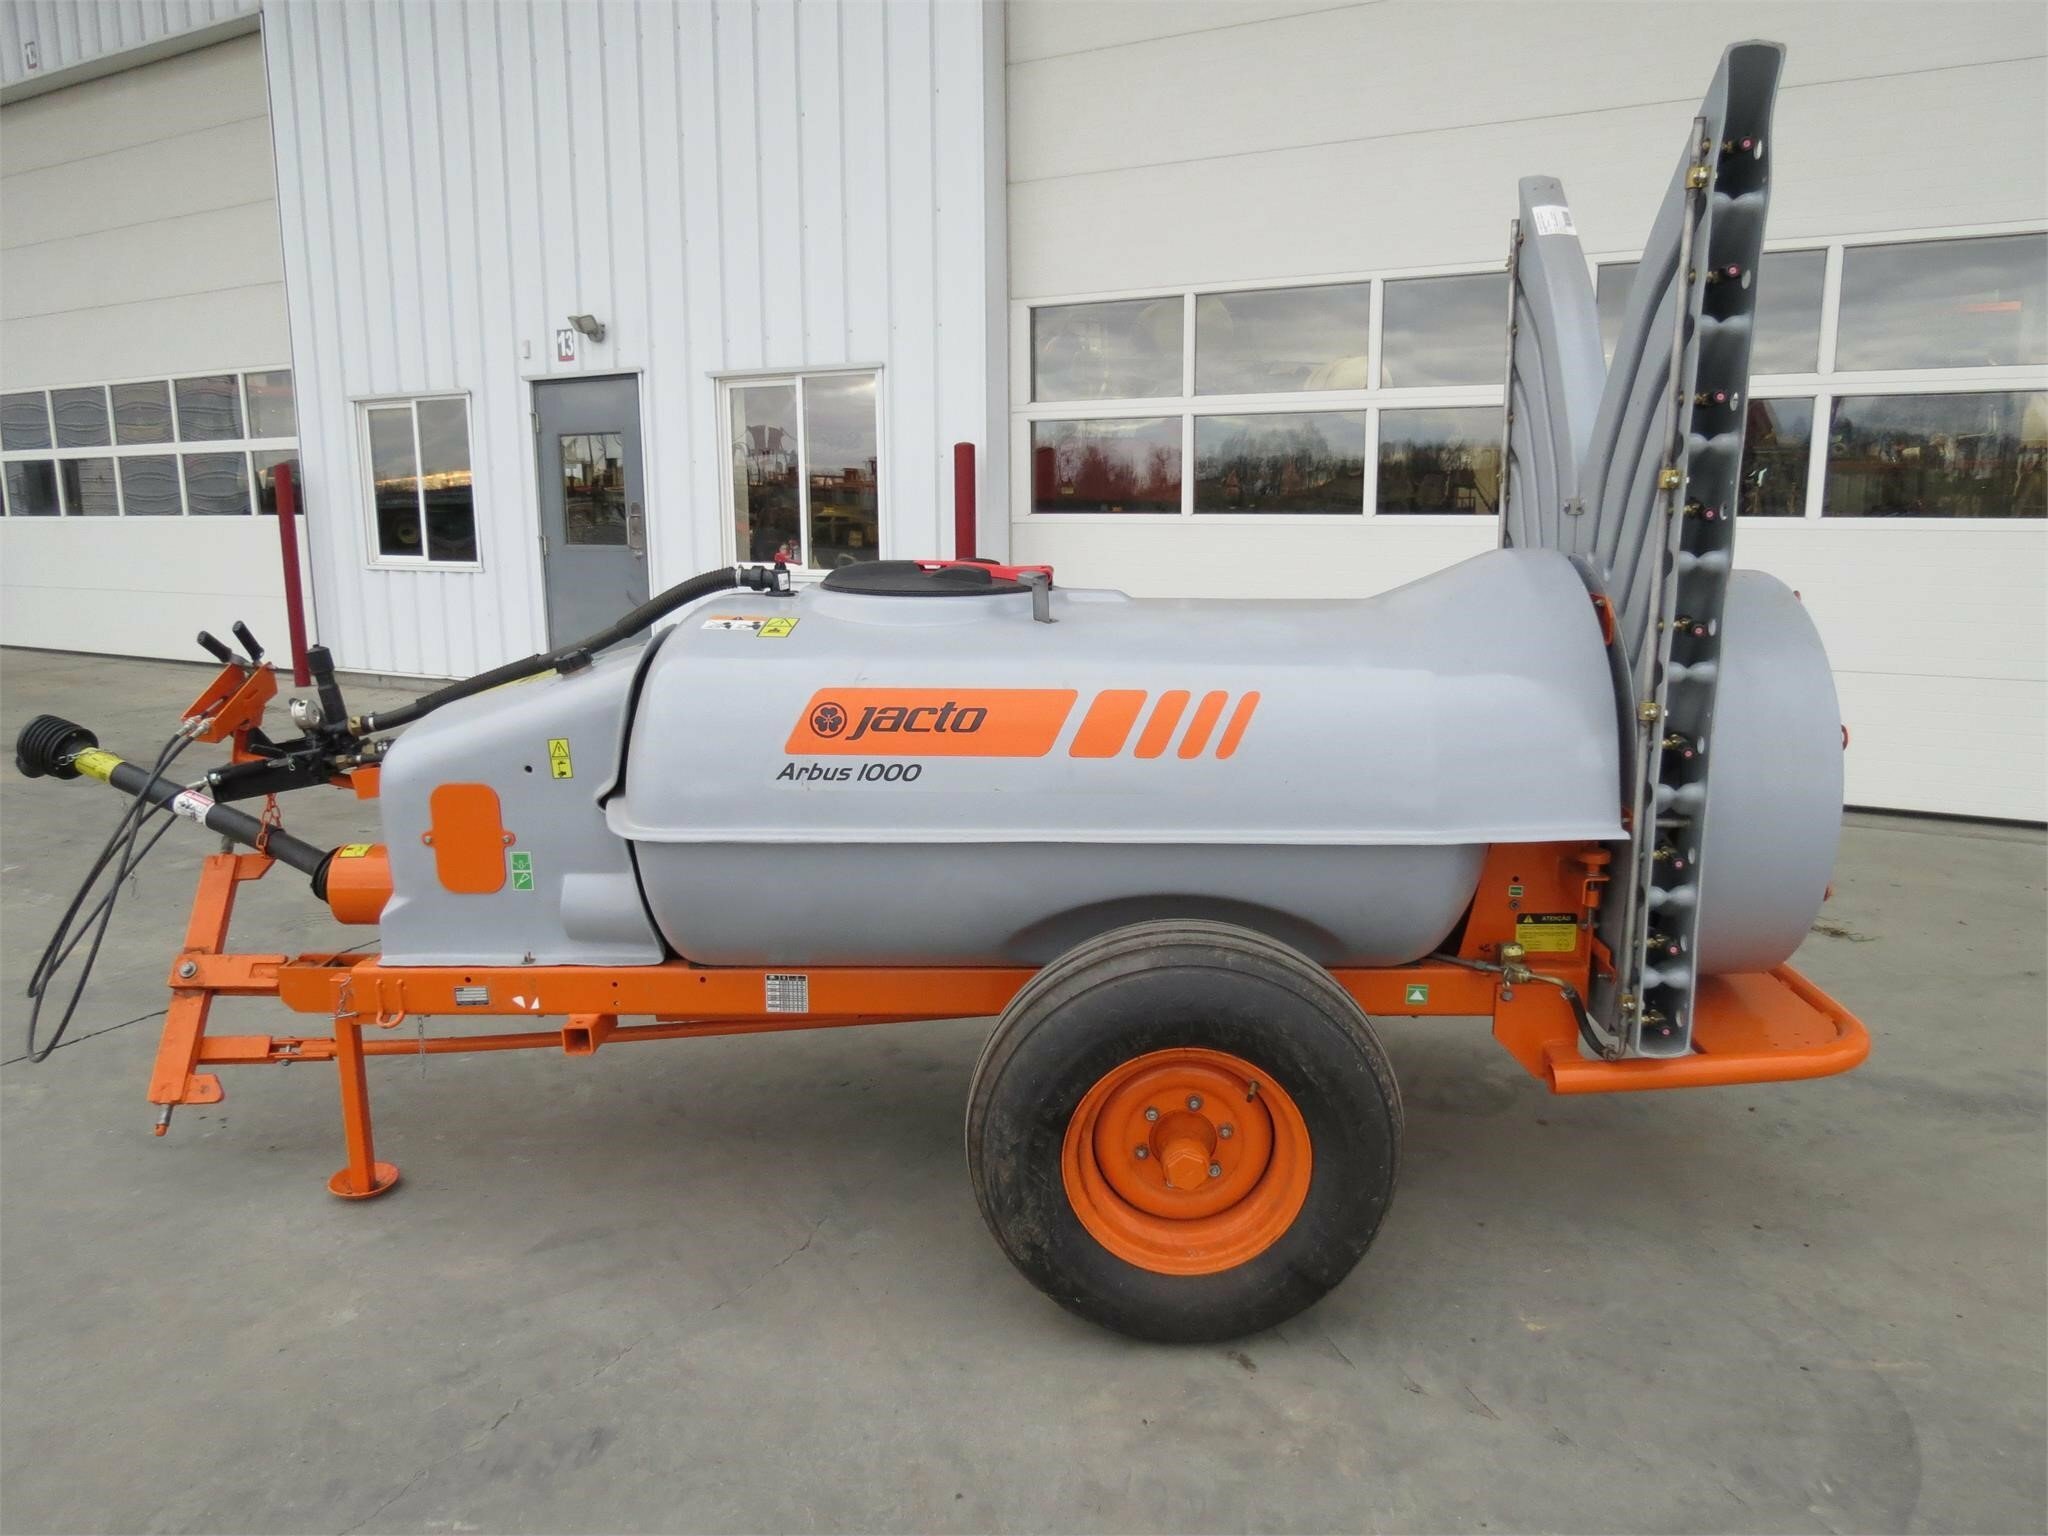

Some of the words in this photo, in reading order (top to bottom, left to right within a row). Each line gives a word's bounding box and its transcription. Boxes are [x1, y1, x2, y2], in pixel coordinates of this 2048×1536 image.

[558, 330, 575, 357] 13
[776, 762, 853, 781] Arbus
[857, 763, 923, 782] 1000
